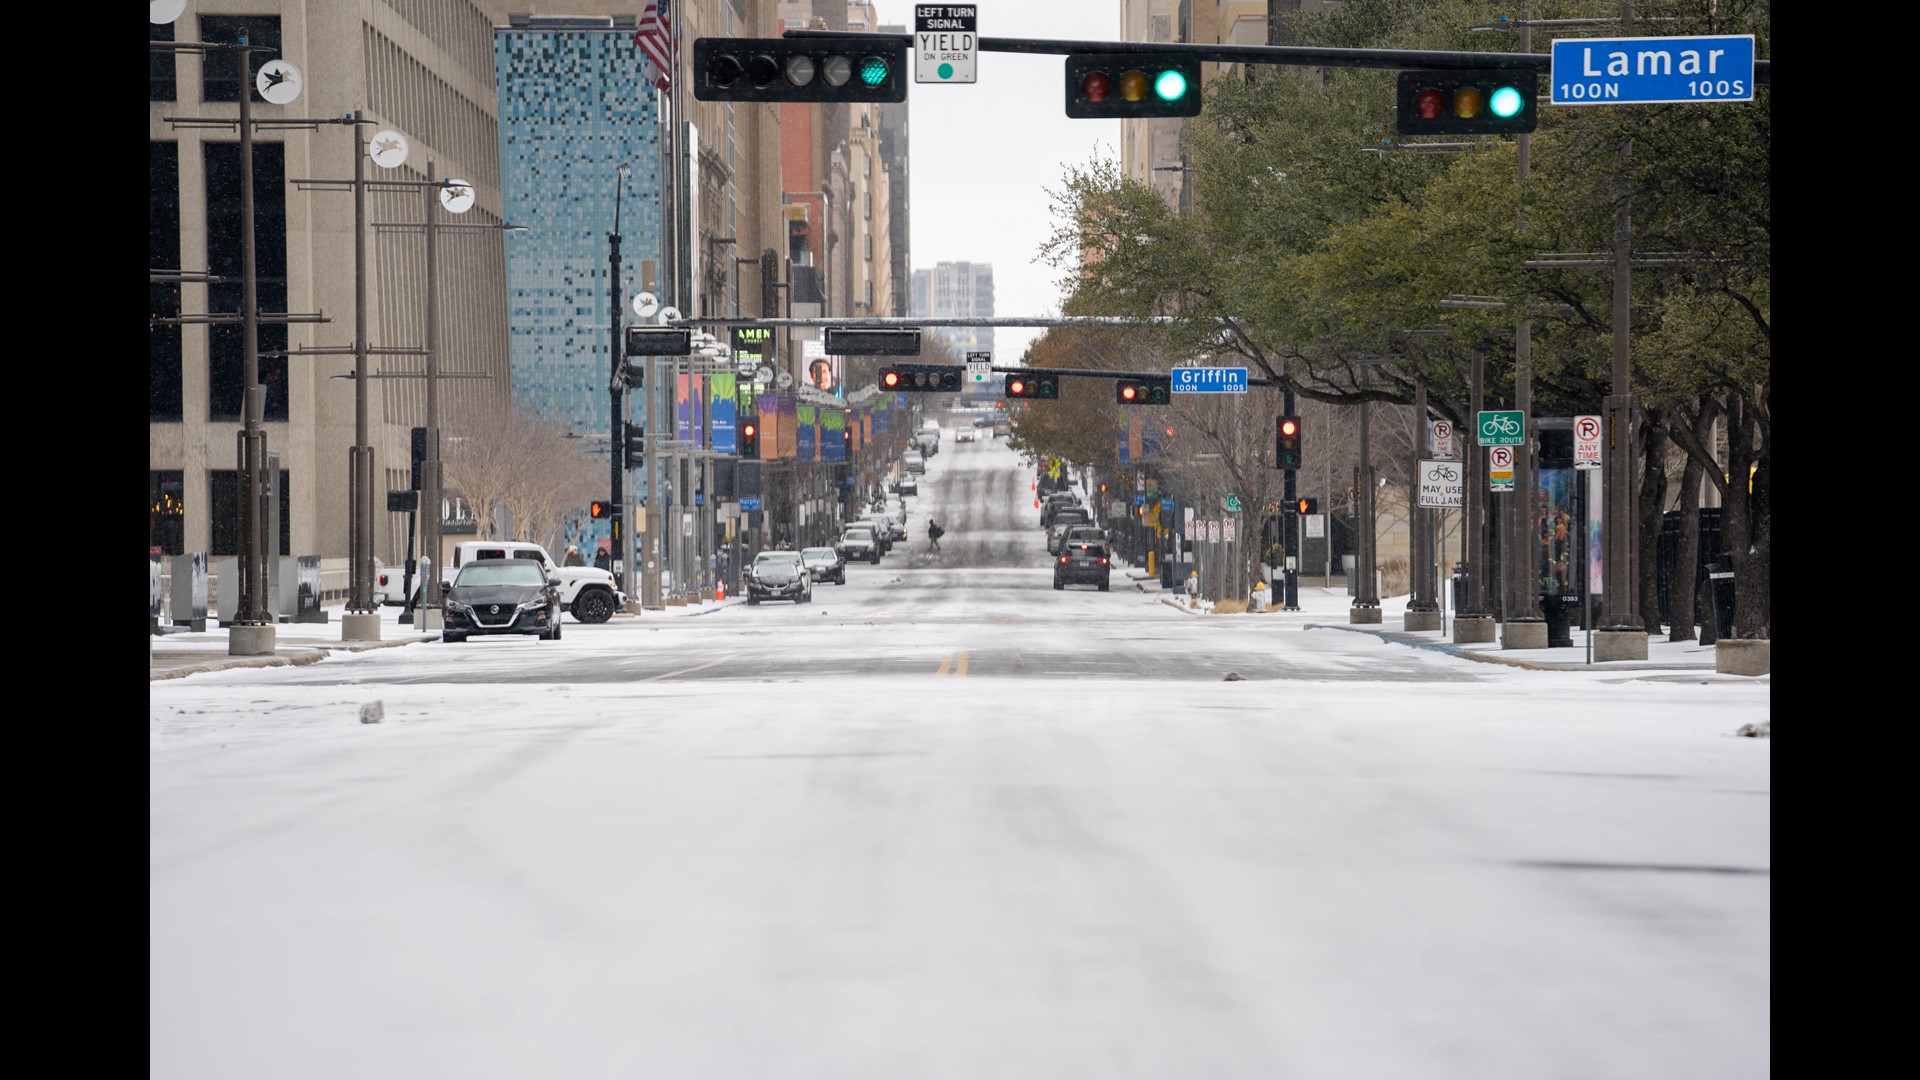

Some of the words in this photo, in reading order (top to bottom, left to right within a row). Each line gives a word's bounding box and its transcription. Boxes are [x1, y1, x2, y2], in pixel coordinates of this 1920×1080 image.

[918, 7, 943, 17] LEFT
[947, 7, 974, 17] TURN
[927, 19, 965, 29] SIGNAL
[920, 34, 972, 51] YIELD
[924, 53, 936, 61] ON
[941, 53, 968, 61] GREEN
[1583, 48, 1724, 77] Lamar
[1560, 83, 1619, 99] 100N
[1688, 80, 1744, 97] 100S
[1181, 369, 1238, 384] Griffin
[1500, 436, 1523, 444] ROUTE
[1578, 444, 1597, 452] ANY
[1577, 451, 1599, 459] TIME
[1422, 484, 1441, 493] MAY
[1445, 486, 1463, 495] USE
[1421, 496, 1439, 504] FULL
